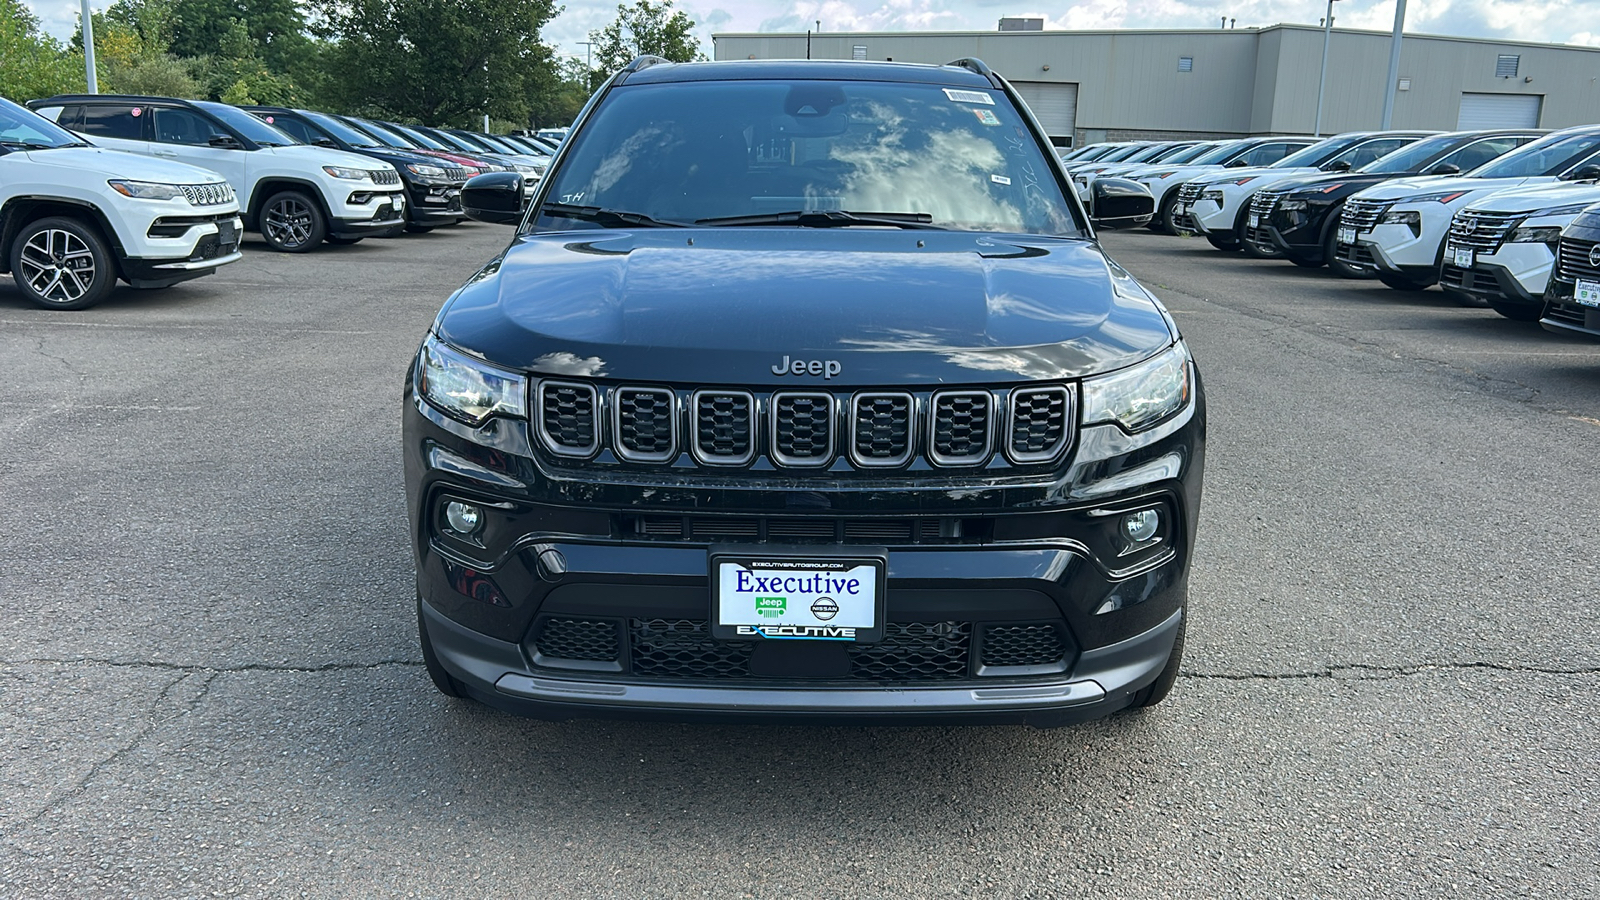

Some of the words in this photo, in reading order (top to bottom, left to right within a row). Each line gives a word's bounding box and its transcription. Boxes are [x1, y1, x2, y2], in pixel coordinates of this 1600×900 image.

[558, 192, 585, 205] JH
[771, 355, 842, 379] Jeep
[736, 570, 860, 595] Executive
[759, 598, 783, 608] Jeep
[737, 625, 856, 637] EXECUTIVE
